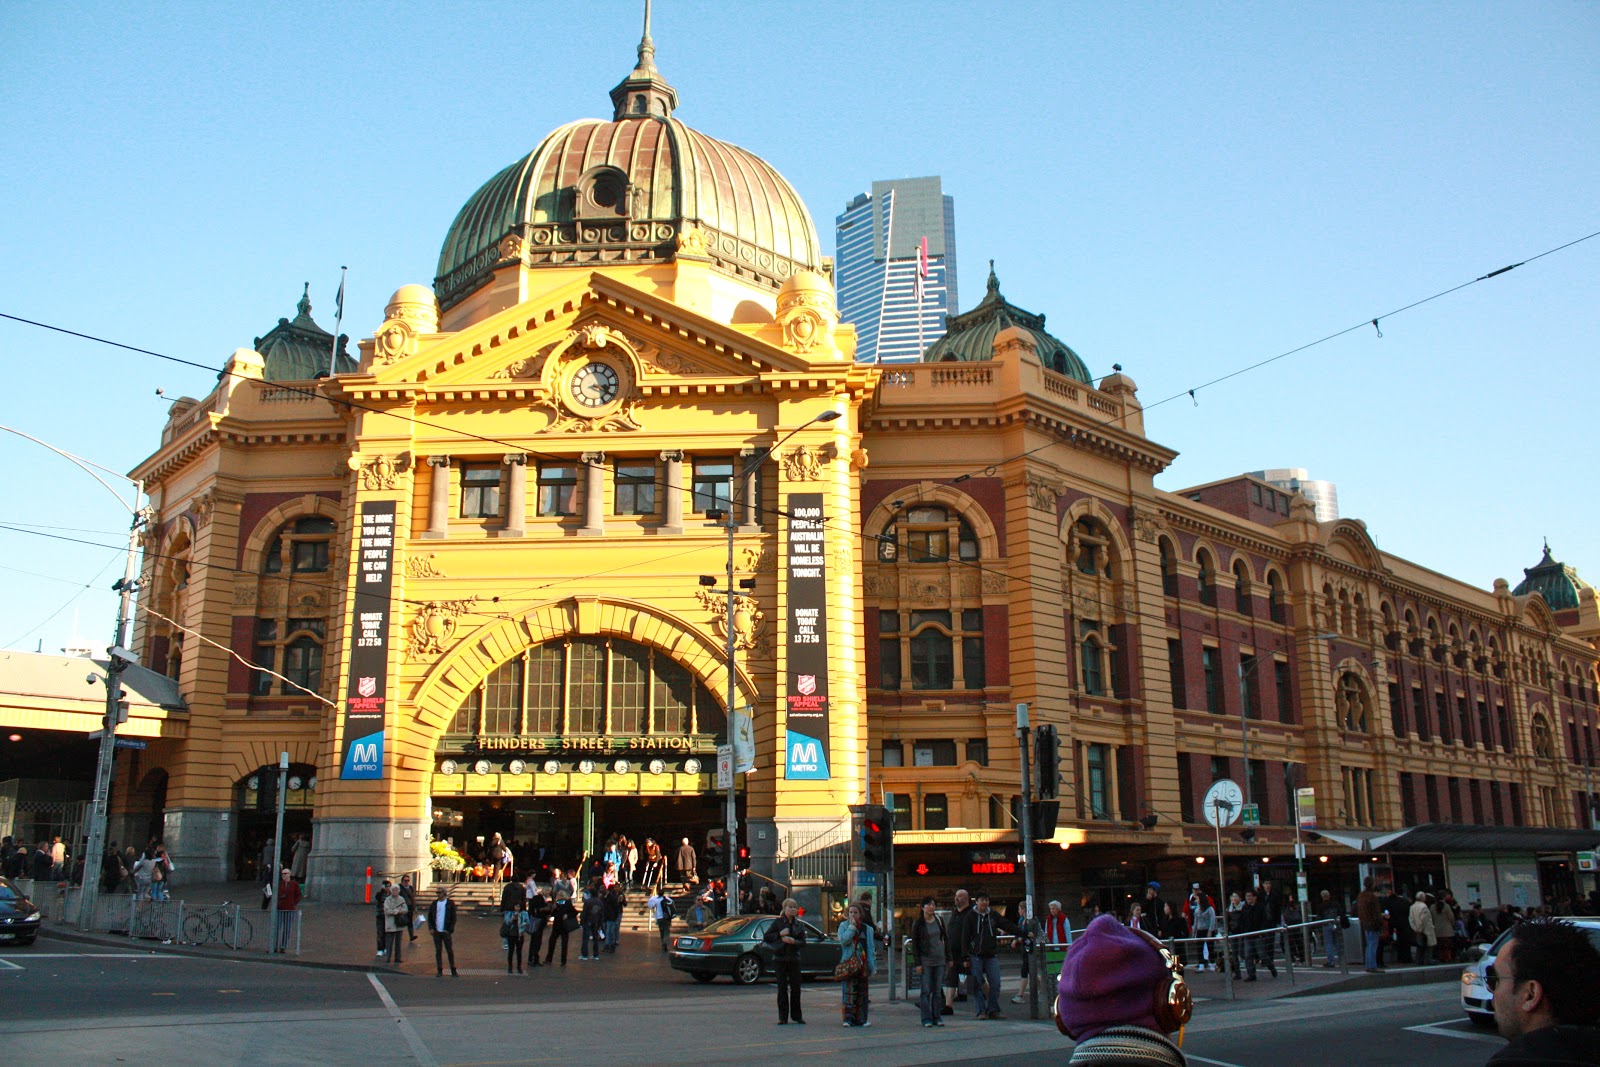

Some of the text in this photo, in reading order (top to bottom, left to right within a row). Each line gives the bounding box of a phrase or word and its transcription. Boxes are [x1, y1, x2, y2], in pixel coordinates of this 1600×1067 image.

[794, 508, 820, 518] 100,000
[363, 514, 393, 523] THE MORE
[791, 520, 815, 529] PEOPLE
[363, 526, 375, 535] YOU
[790, 532, 824, 541] AUSTRALIA
[361, 538, 392, 547] THE MORE
[794, 544, 820, 553] WILL BE
[364, 550, 387, 559] PEOPLE
[790, 556, 824, 565] HOMELESS
[363, 561, 387, 570] WE CAN
[361, 612, 383, 621] DONATE
[795, 609, 819, 617] DONATE
[363, 630, 378, 638] CALL
[799, 626, 814, 634] CALL
[358, 638, 382, 646] 13 72 58
[794, 635, 819, 643] 13 72 58
[478, 737, 692, 750] FLINDERS STREET STATION
[792, 764, 817, 772] METRO
